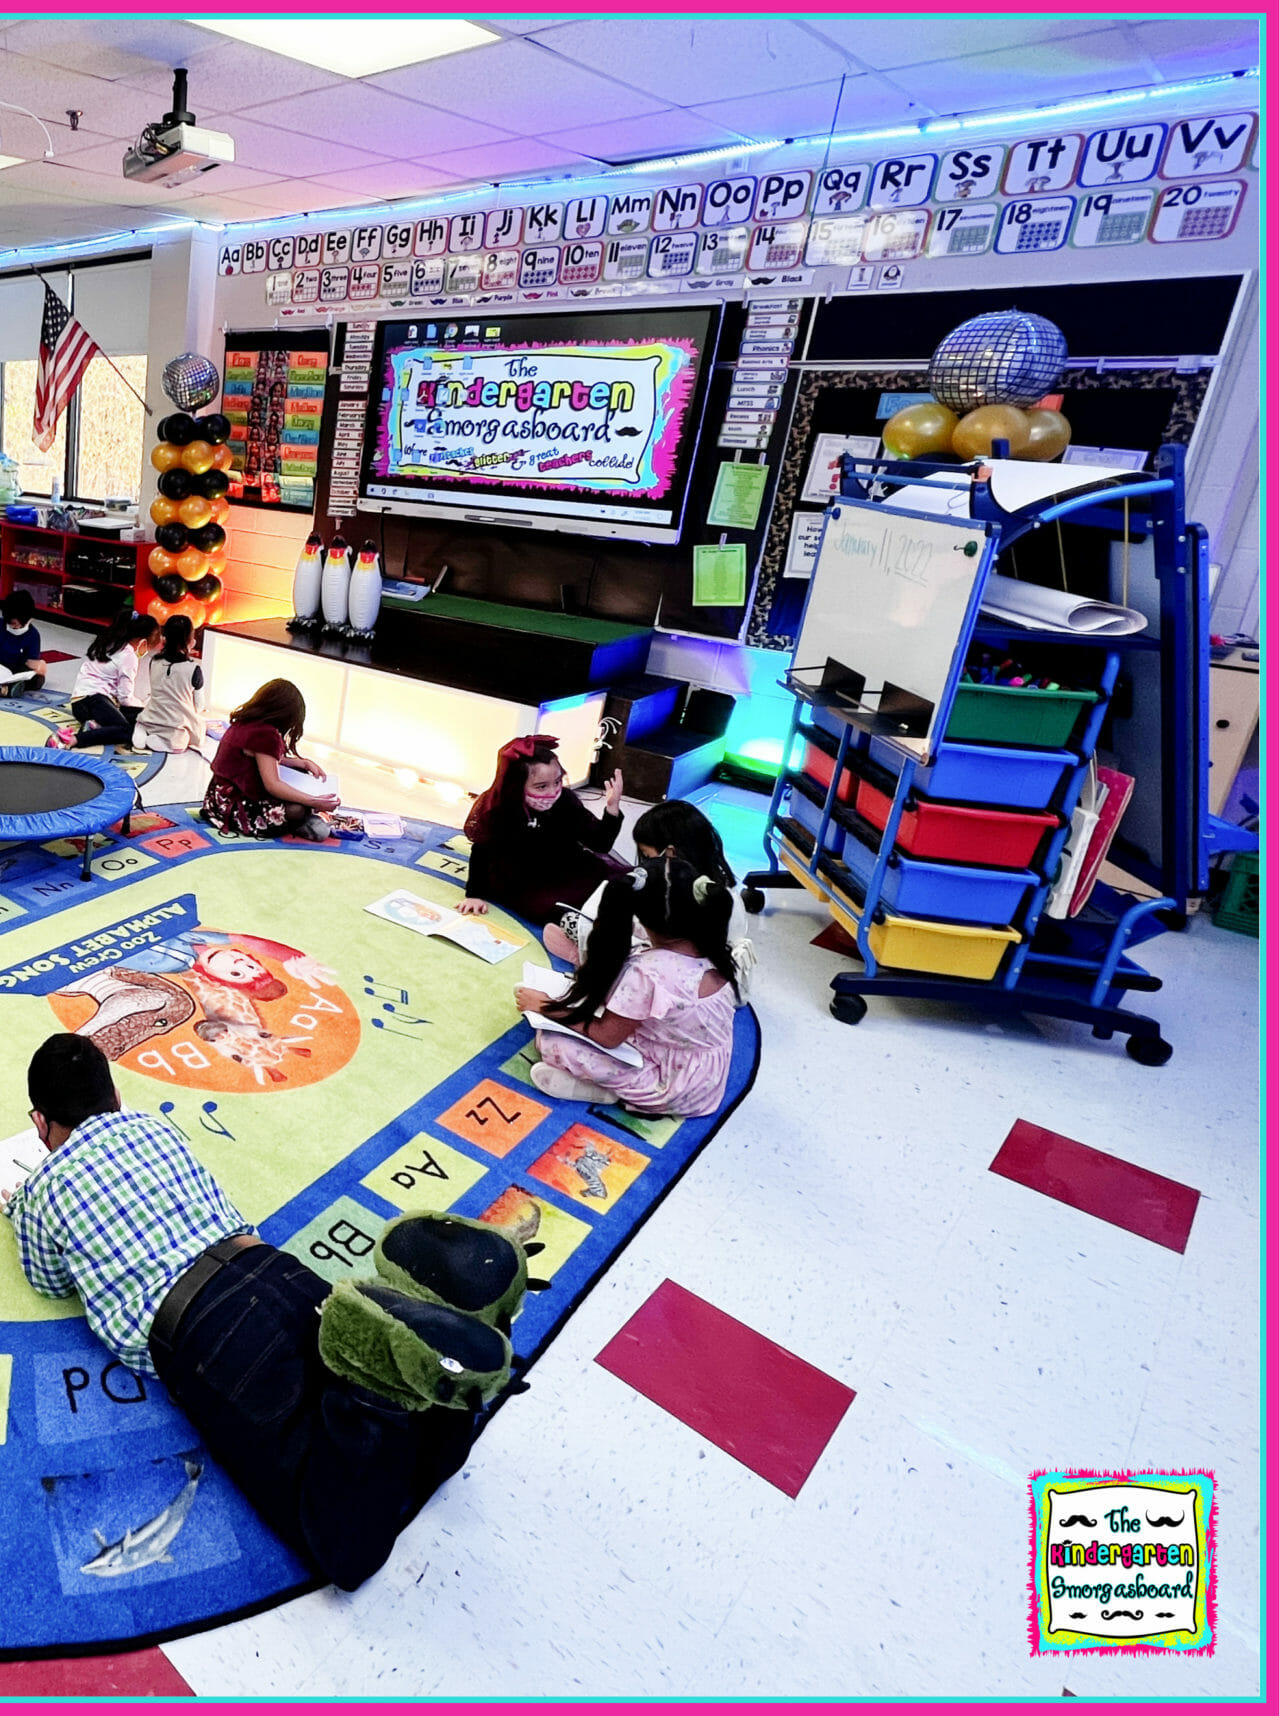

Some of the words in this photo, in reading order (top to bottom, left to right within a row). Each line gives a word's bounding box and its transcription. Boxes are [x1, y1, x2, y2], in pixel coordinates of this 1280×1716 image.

[1097, 130, 1153, 162] Uu
[1180, 120, 1247, 153] Vv
[949, 151, 992, 180] Ss
[1027, 138, 1066, 172] Tt
[822, 169, 861, 193] Qq
[880, 161, 926, 189] Rr
[659, 188, 696, 214] Nn
[710, 182, 751, 208] Oo
[763, 177, 804, 206] Pp
[1162, 186, 1202, 207] 20
[1204, 189, 1239, 198] twenty
[576, 199, 596, 222] Ll
[611, 196, 650, 215] Mm
[1008, 204, 1031, 224] 18
[1083, 195, 1113, 217] 19
[459, 215, 475, 236] Ii
[496, 210, 513, 236] Jj
[529, 206, 557, 228] Kk
[937, 209, 962, 230] 17
[357, 228, 378, 248] Ff
[387, 225, 410, 247] Gg
[419, 220, 443, 241] Hh
[702, 231, 718, 251] 13
[755, 227, 775, 246] 14
[246, 244, 264, 260] Bb
[272, 239, 291, 257] Cc
[298, 236, 319, 254] Dd
[326, 232, 347, 251] Ee
[654, 237, 672, 253] 12
[222, 247, 240, 264] Aa
[487, 254, 497, 272] 8
[524, 251, 537, 270] 9
[537, 255, 554, 264] nine
[565, 245, 584, 265] 10
[584, 249, 599, 258] ten
[608, 242, 619, 263] 11
[620, 243, 647, 252] eleven
[323, 271, 331, 287] 3
[353, 269, 363, 284] 4
[383, 266, 393, 282] 5
[394, 269, 407, 277] five
[415, 260, 426, 278] 6
[296, 272, 305, 288] 2
[505, 357, 538, 378] The
[529, 446, 560, 466] great
[538, 450, 593, 472] teachers
[156, 838, 193, 850] Pp
[101, 858, 138, 870] Oo
[440, 858, 467, 873] Tt
[33, 881, 75, 898] Nn
[69, 903, 187, 957] ALPHABET
[121, 931, 162, 952] Zoo
[69, 949, 121, 972] Crew
[299, 992, 344, 1031] Aa
[138, 1041, 211, 1076] Bb
[465, 1096, 521, 1125] Zz
[391, 1150, 449, 1189] Aa
[310, 1219, 376, 1268] Bb
[62, 1360, 147, 1414] Dd
